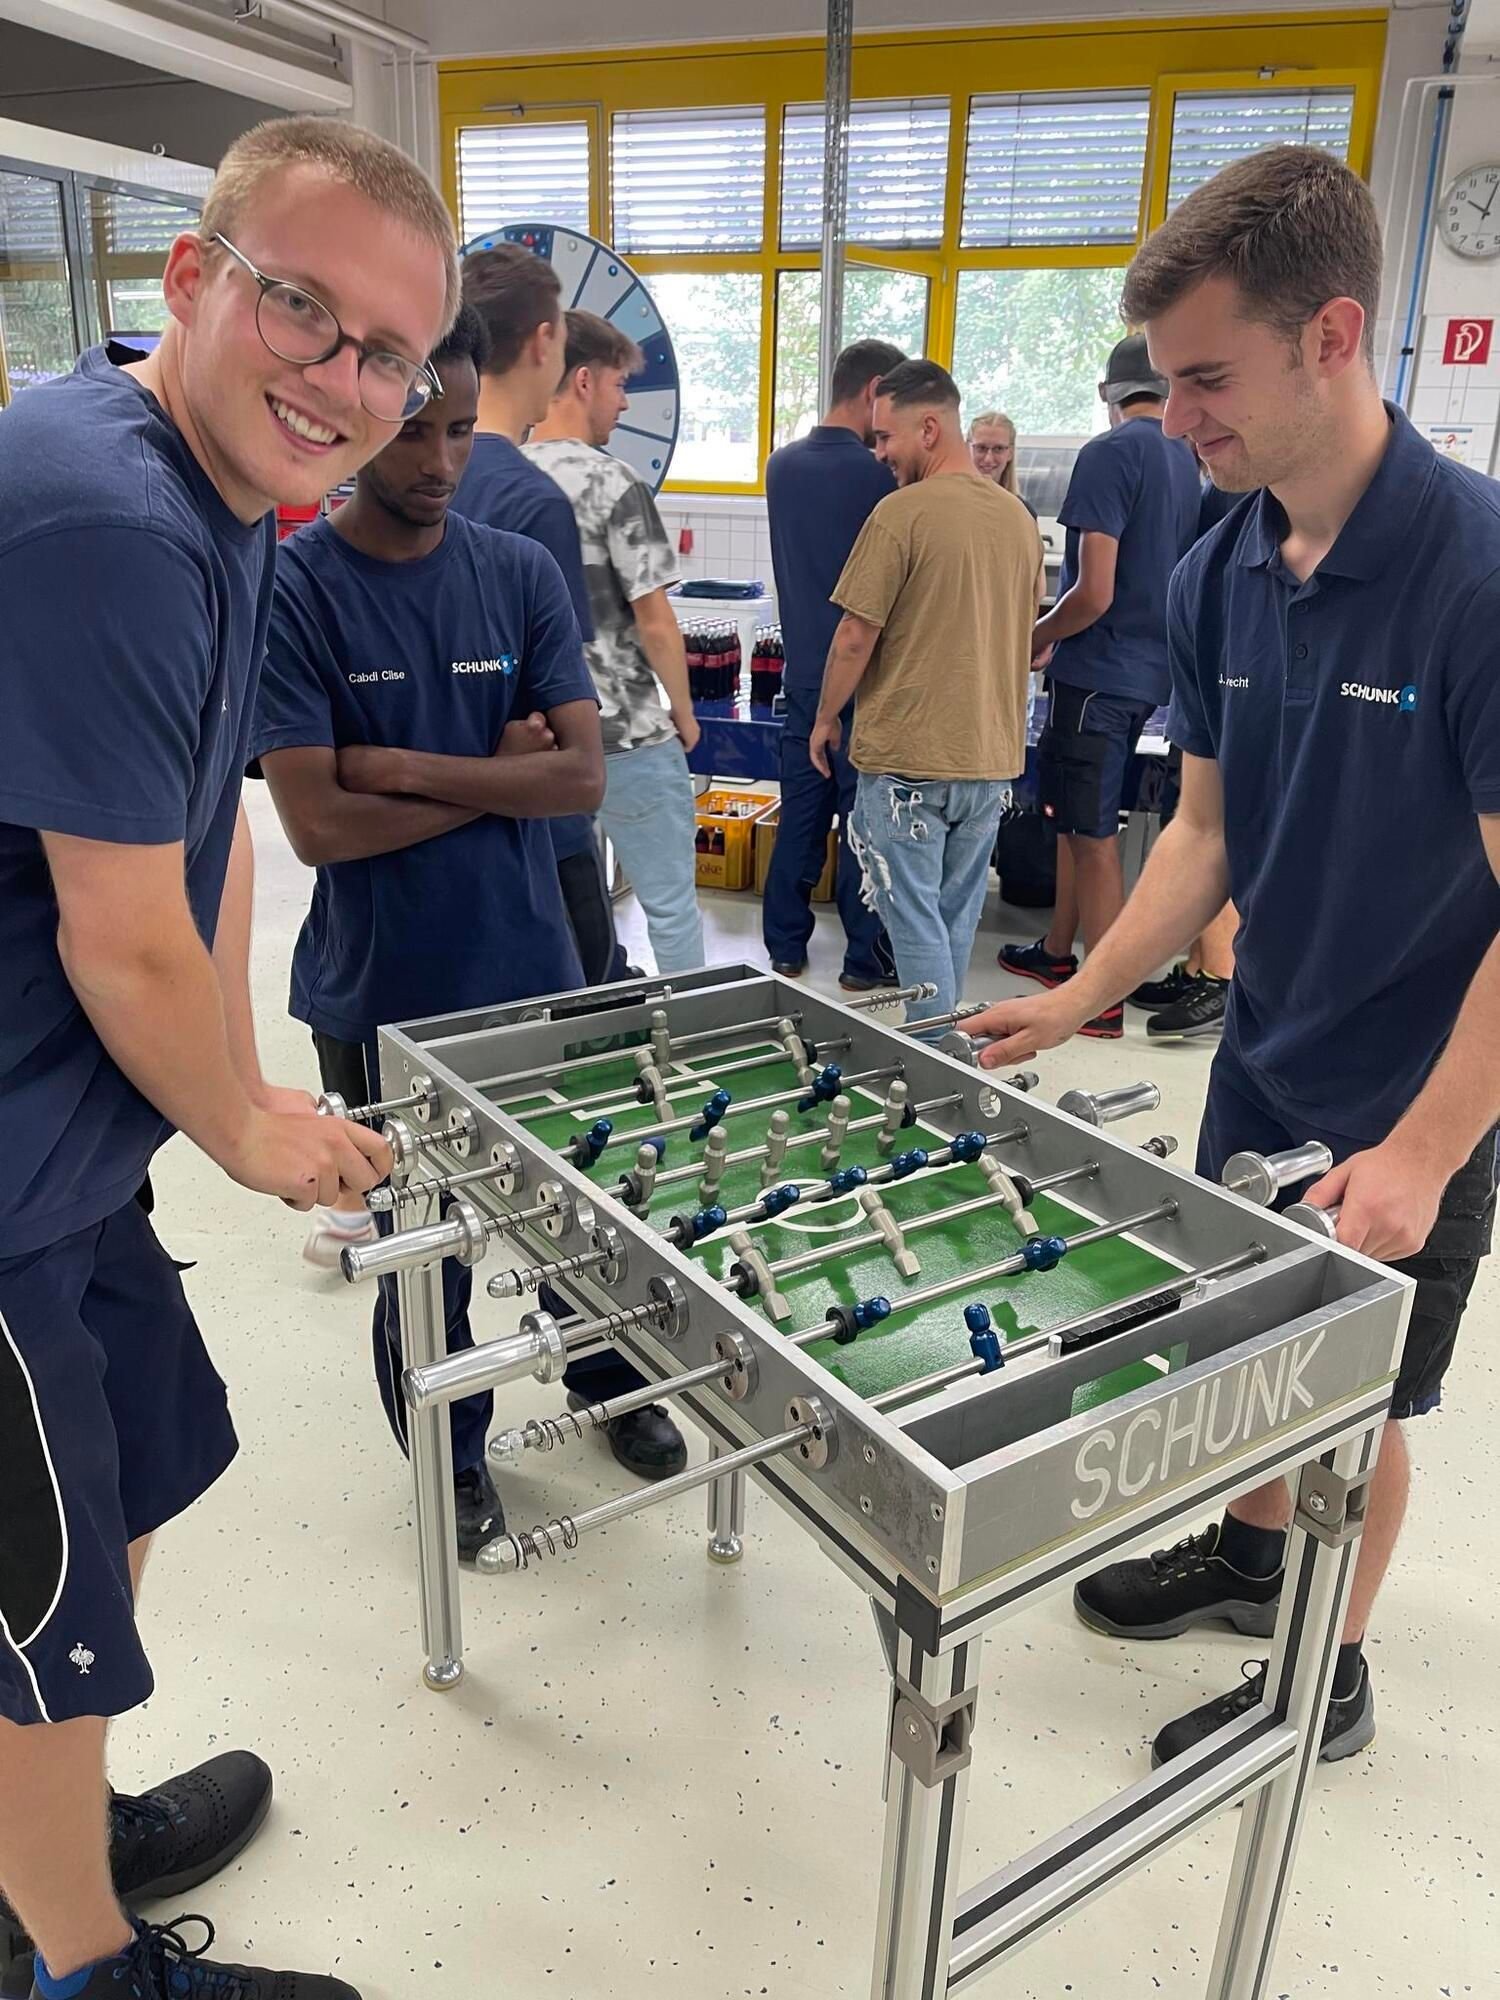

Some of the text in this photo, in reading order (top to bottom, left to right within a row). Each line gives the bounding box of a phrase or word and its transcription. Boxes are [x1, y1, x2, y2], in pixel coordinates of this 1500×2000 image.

[1470, 179, 1477, 188] 11
[1486, 173, 1499, 184] 12
[1456, 191, 1467, 201] 10
[1449, 206, 1458, 217] 9
[1450, 222, 1460, 233] 8
[1460, 234, 1468, 245] 7
[1476, 240, 1485, 250] 6
[452, 659, 502, 673] SCHUNK
[1340, 682, 1400, 704] SCHUNK
[1071, 1329, 1326, 1519] SCHUNK
